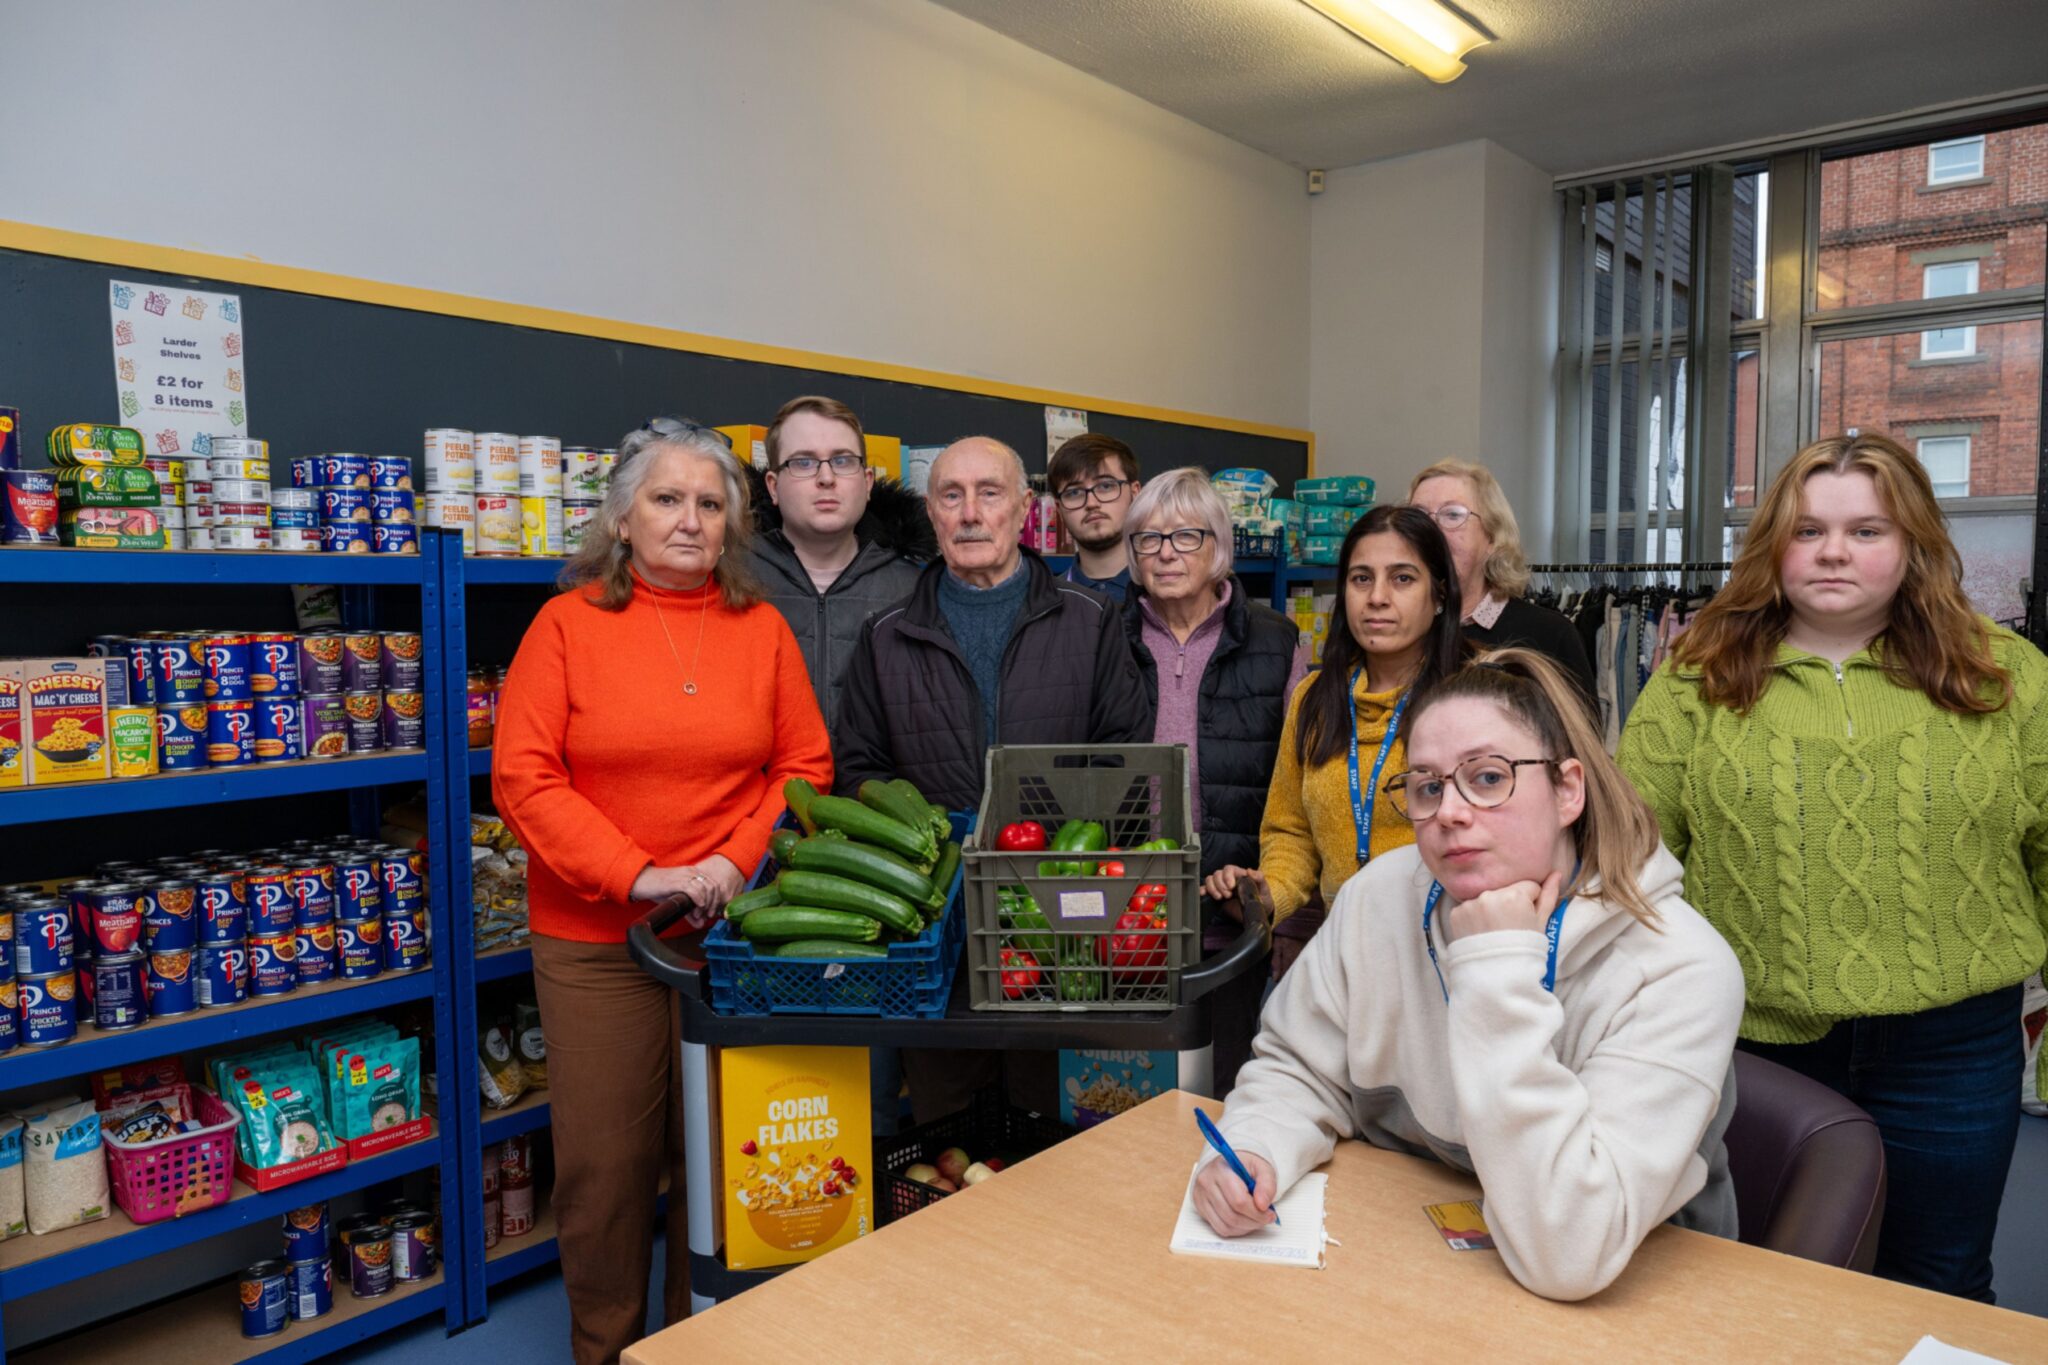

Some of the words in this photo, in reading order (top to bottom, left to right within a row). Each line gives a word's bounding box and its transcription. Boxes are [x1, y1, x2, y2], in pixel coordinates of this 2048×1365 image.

[163, 337, 197, 347] Larder
[160, 349, 201, 360] Shelves
[157, 376, 176, 387] £2
[181, 377, 204, 389] for
[155, 394, 164, 405] 8
[169, 395, 213, 408] items
[22, 483, 53, 491] BENTOS
[28, 674, 103, 694] CHEESEY
[35, 695, 56, 706] MAC
[69, 693, 99, 704] CHEESE
[119, 716, 147, 726] HEINZ
[1389, 713, 1400, 733] STAFF
[1377, 744, 1388, 765] STAFF
[1367, 778, 1376, 800] STAFF
[1354, 803, 1362, 825] STAFF
[107, 898, 128, 906] FRAY
[1428, 883, 1441, 904] AFF
[102, 903, 134, 913] BENTOS
[99, 916, 138, 928] Meatballs
[30, 1006, 61, 1015] PRINCES
[30, 1015, 61, 1025] CHICKEN
[768, 1095, 828, 1122] CORN
[34, 1122, 97, 1147] SAVERS
[117, 1116, 160, 1141] UPER
[362, 1130, 408, 1148] MICROWAVEABLE
[410, 1124, 421, 1133] RICE
[758, 1117, 839, 1147] FLAKES
[270, 1160, 322, 1178] MICROWAVEABLE
[324, 1154, 337, 1163] RICE
